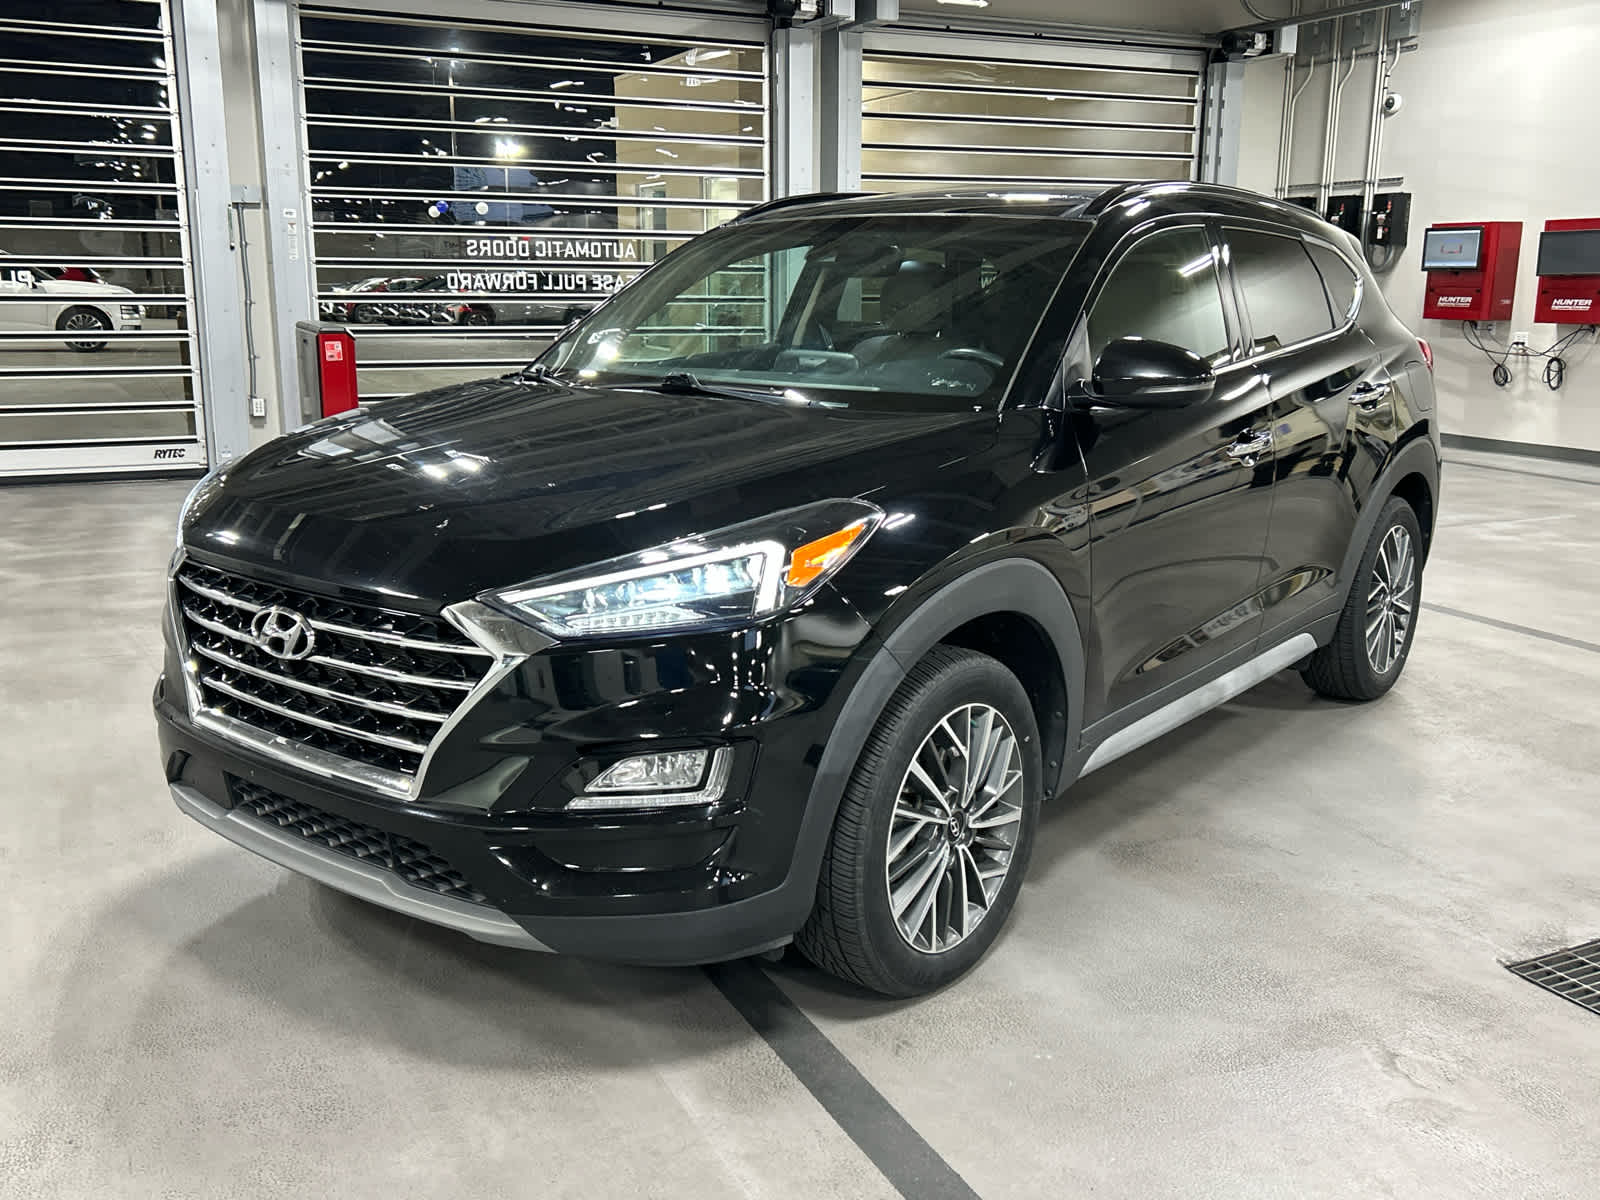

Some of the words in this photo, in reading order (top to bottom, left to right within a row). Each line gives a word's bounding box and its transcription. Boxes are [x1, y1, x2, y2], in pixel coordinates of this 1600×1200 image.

[1438, 296, 1472, 304] HUNTER
[1552, 298, 1592, 306] HUNTER
[153, 448, 186, 459] RYTEC
